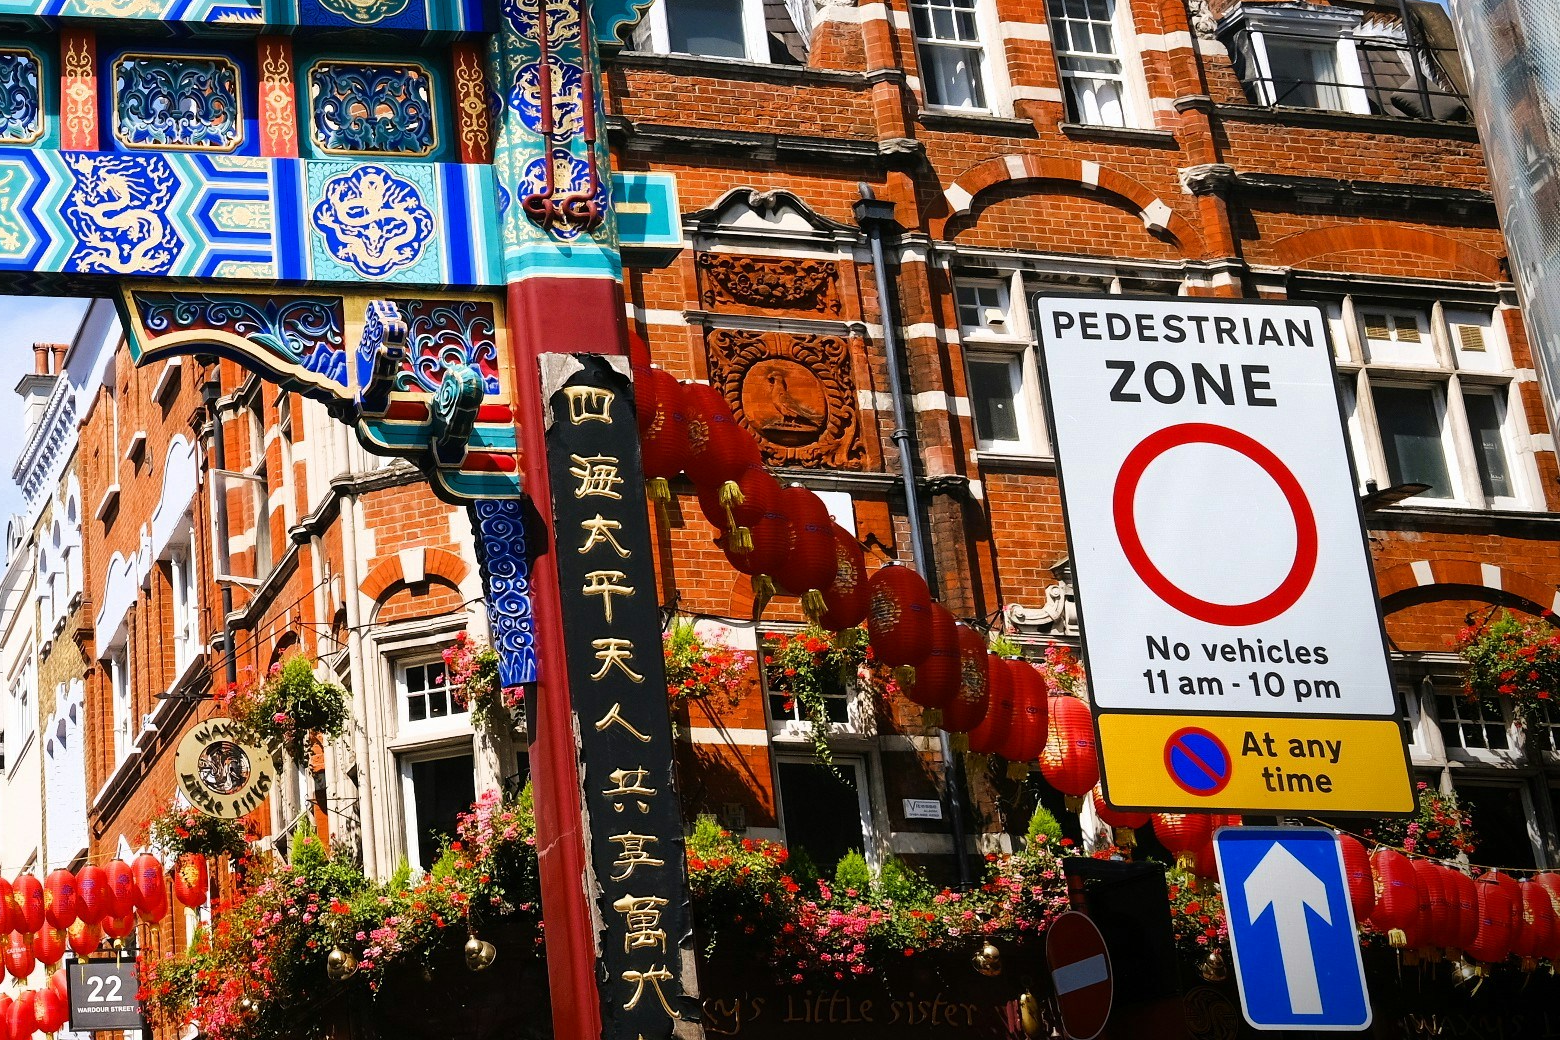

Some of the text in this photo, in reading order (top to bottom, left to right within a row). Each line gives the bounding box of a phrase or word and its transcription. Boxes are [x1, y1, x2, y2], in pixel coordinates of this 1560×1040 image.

[1053, 310, 1315, 347] PEDESTRIAN
[1106, 359, 1278, 408] ZONE
[1146, 635, 1330, 667] No vehicles
[1248, 671, 1286, 699] 10
[1294, 678, 1342, 705] pm
[562, 385, 682, 1040] 四海太平天人共享萬代
[1241, 732, 1342, 765] At any
[1261, 766, 1333, 794] time
[86, 975, 123, 1002] 22
